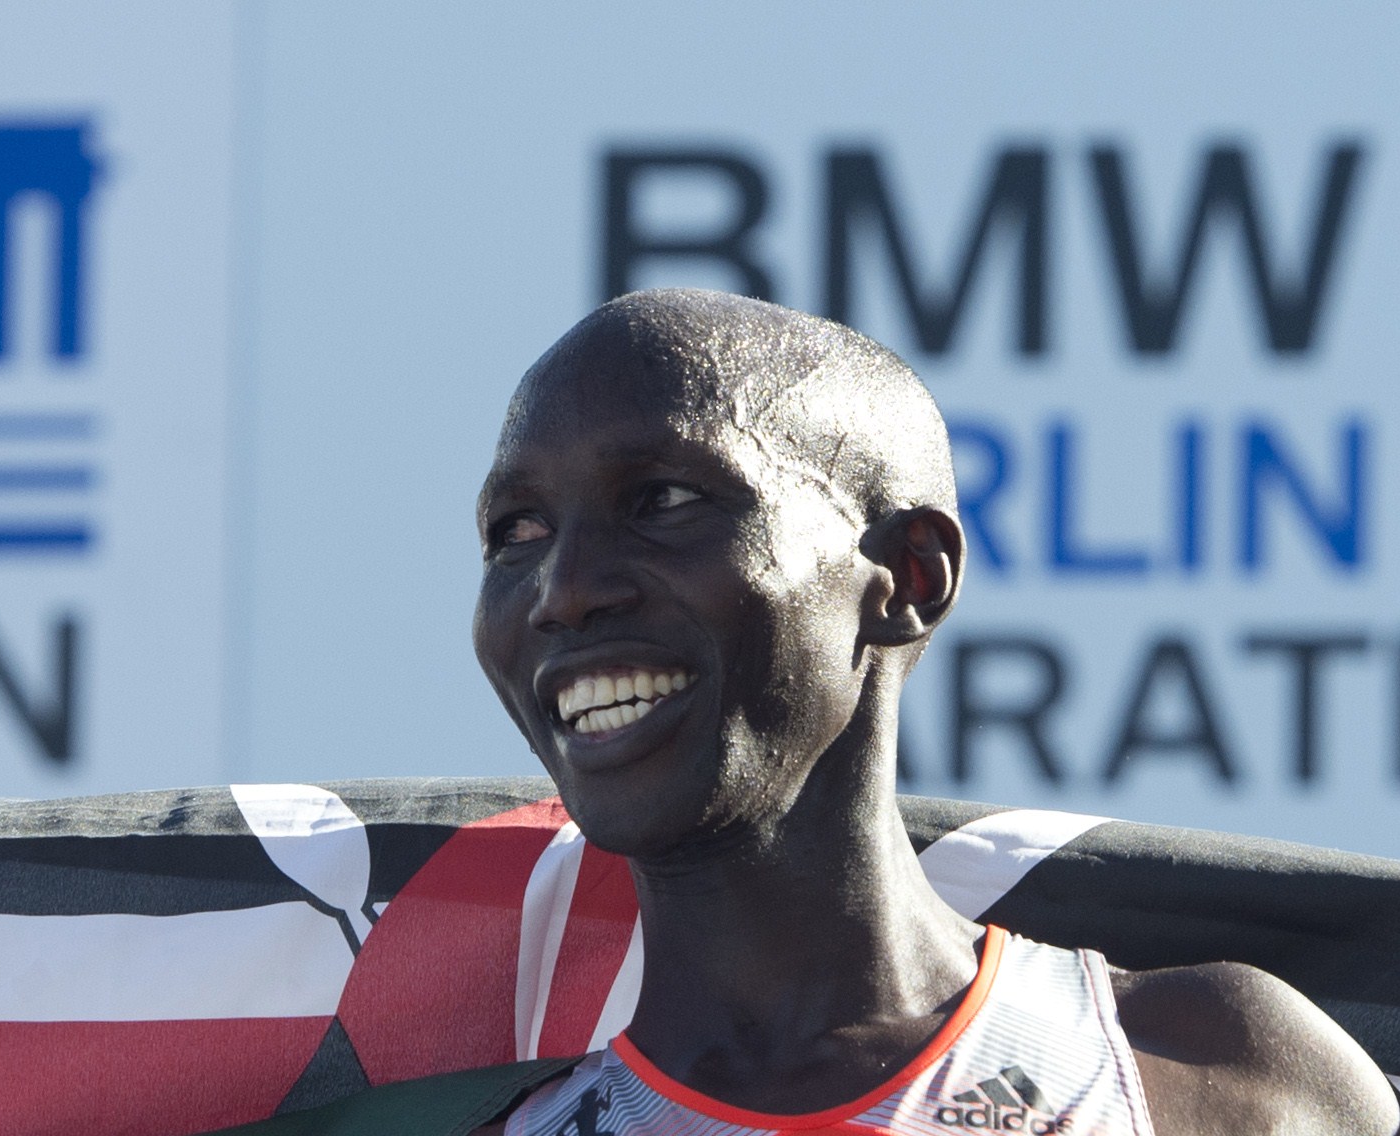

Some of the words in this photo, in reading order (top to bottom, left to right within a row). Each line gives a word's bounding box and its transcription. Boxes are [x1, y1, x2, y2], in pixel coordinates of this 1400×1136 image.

[595, 137, 1371, 361] BMW
[948, 414, 1375, 579] RLIN
[937, 1102, 1074, 1136] adidas
